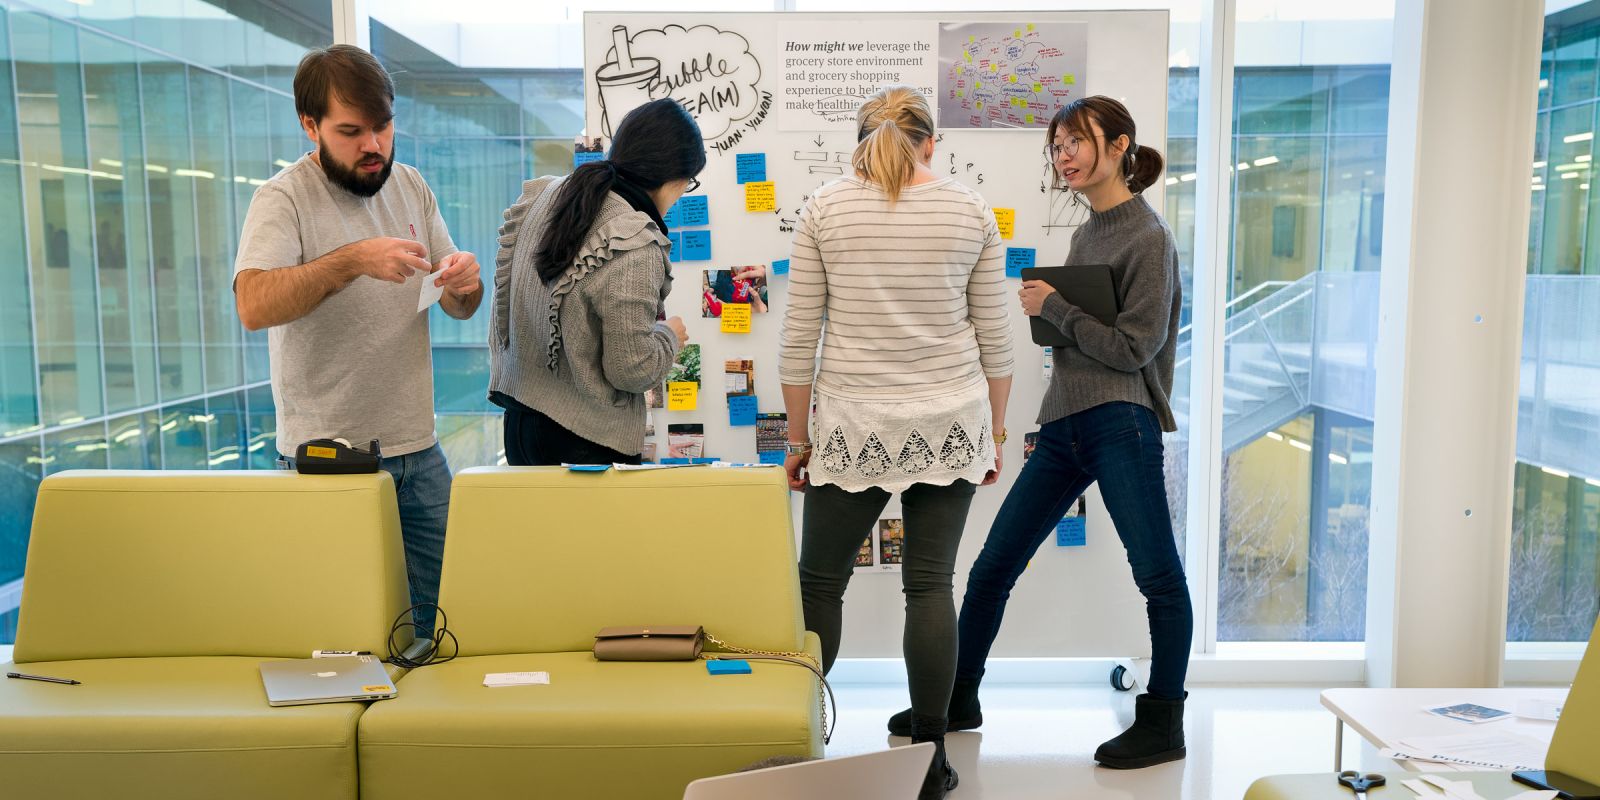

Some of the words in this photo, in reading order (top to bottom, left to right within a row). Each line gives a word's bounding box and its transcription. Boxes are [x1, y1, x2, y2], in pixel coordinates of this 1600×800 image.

[785, 41, 811, 51] How
[813, 41, 846, 54] might
[848, 43, 864, 51] we
[866, 41, 911, 53] leverage
[913, 41, 931, 51] the
[785, 58, 825, 68] grocery
[827, 57, 853, 66] store
[855, 56, 923, 66] environment
[637, 52, 740, 102] Bubble
[785, 70, 805, 80] and
[808, 72, 848, 82] grocery
[850, 70, 900, 82] shopping
[785, 84, 843, 97] experience
[846, 86, 856, 95] to
[677, 81, 740, 119] EA(M)
[785, 99, 814, 110] make
[817, 99, 861, 110] healthie
[977, 173, 984, 184] S
